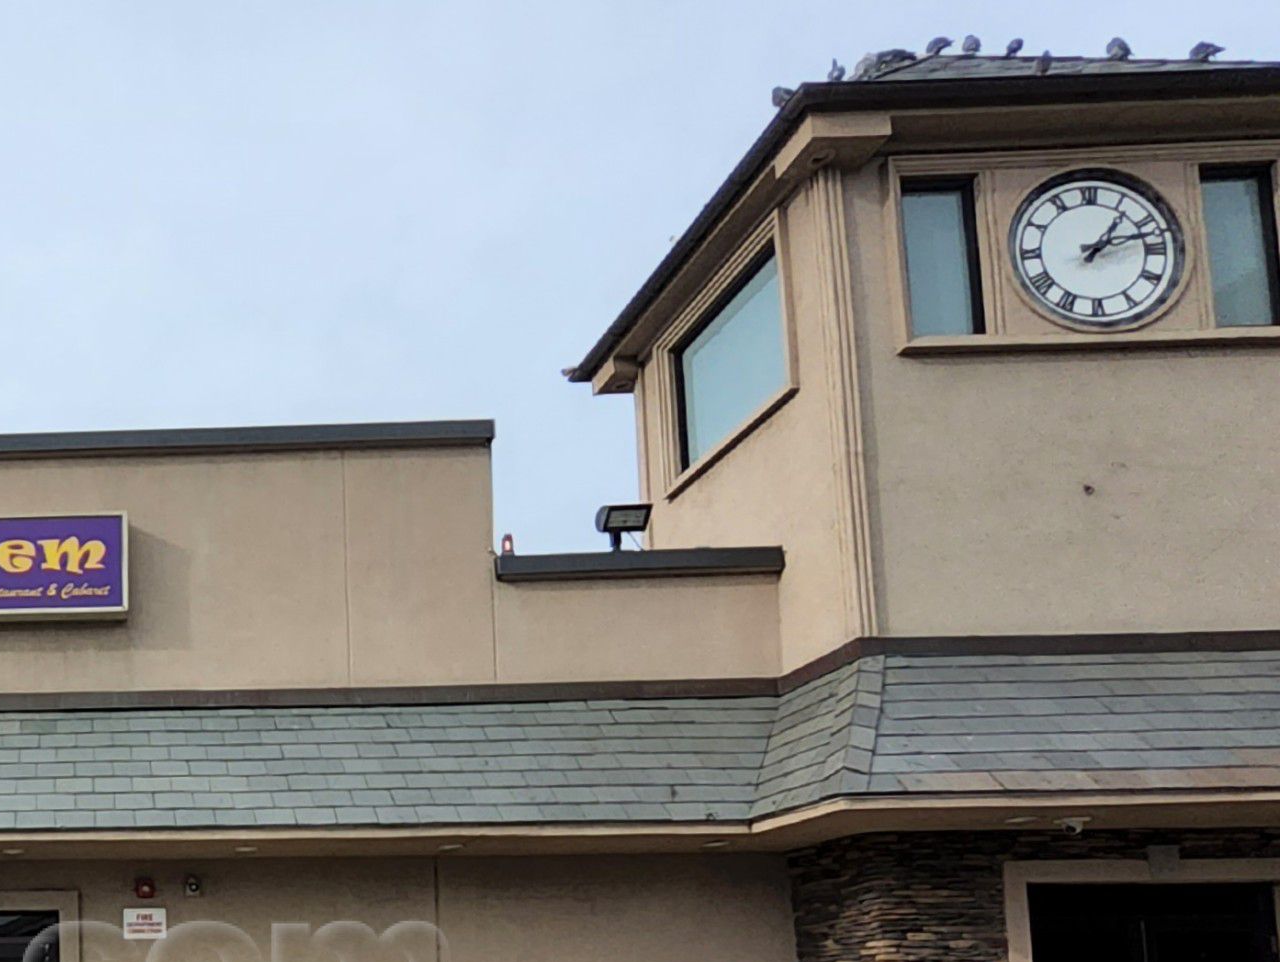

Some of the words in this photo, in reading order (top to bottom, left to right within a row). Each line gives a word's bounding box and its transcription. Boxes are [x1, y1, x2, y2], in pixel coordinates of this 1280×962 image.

[1080, 187, 1098, 206] XII
[1144, 242, 1166, 256] III
[46, 583, 59, 597] &
[60, 582, 111, 600] Cabaret
